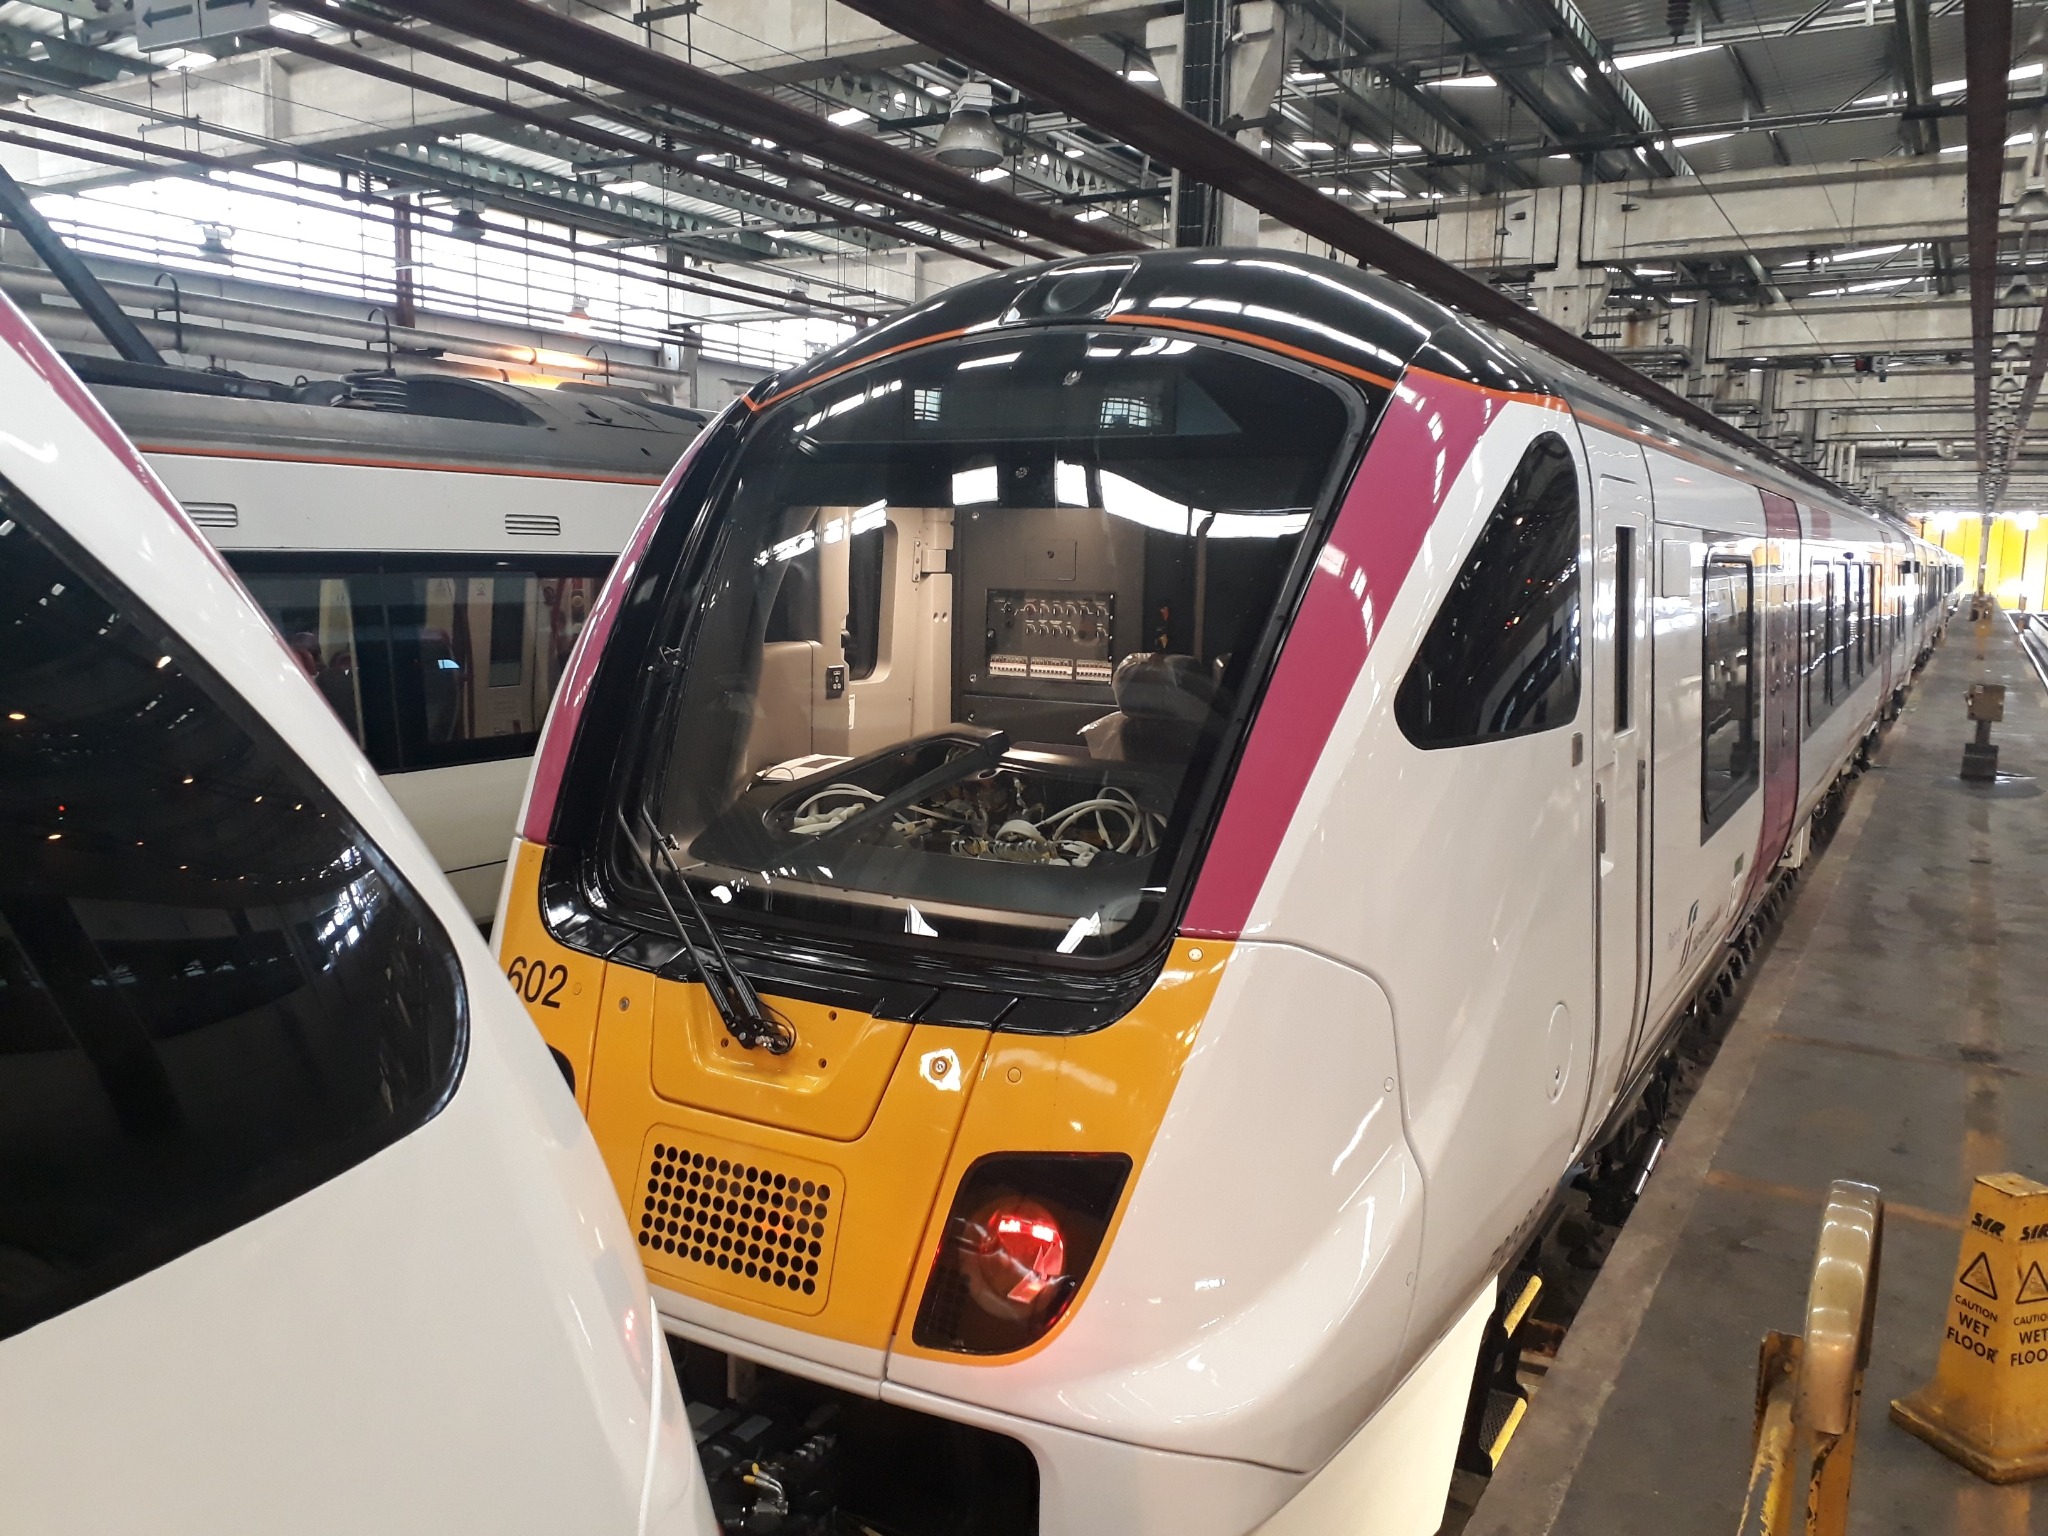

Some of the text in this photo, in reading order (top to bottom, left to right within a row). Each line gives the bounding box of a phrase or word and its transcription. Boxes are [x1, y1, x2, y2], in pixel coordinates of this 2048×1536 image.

[506, 955, 568, 1009] 602
[1971, 1212, 2006, 1237] SIR
[1955, 1294, 1998, 1322] CAUTION
[2013, 1313, 2048, 1326] CAUTIO
[1959, 1311, 1990, 1338] WET
[2019, 1327, 2048, 1346] WET
[1947, 1326, 1999, 1364] FLOOR
[2010, 1348, 2048, 1367] FLOO
